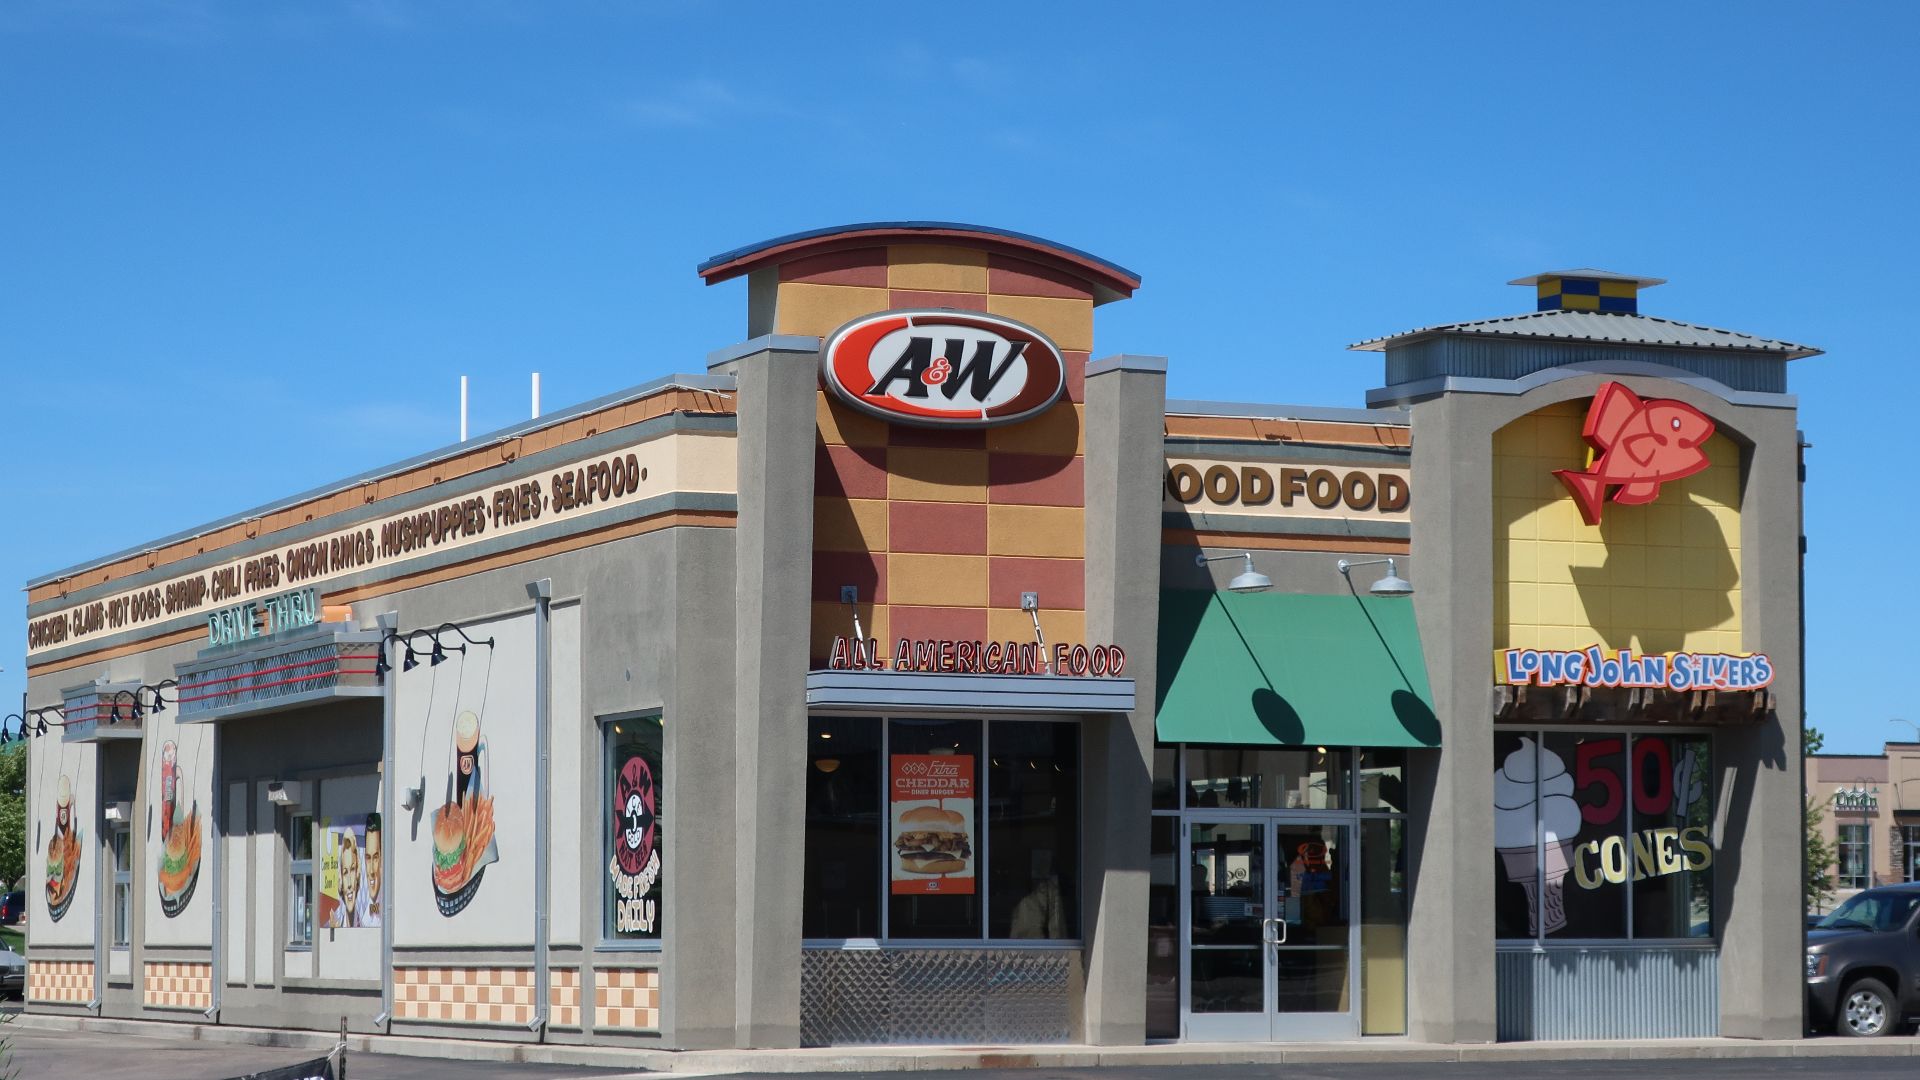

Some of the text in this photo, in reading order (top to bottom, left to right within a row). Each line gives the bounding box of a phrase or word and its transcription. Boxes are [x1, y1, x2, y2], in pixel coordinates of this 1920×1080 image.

[866, 336, 1030, 402] A&W
[1163, 463, 1409, 513] OOD FOOD
[28, 453, 640, 650] CHICKEN CLAMS HOT DOGS SHRIMP CHILI FRIES ONION RINGS HUSHPUPPIES FRIES SEAFOOD
[208, 588, 316, 648] DRIVE THRU
[830, 635, 1126, 677] ALL AMERICAN FOOD
[1506, 649, 1585, 685] LONG
[895, 778, 970, 788] CHEDDAR
[927, 760, 960, 777] Extra
[322, 857, 330, 871] Come
[609, 848, 660, 900] MADE FRESH
[1574, 825, 1713, 890] CONES
[617, 899, 655, 933] DAILY
